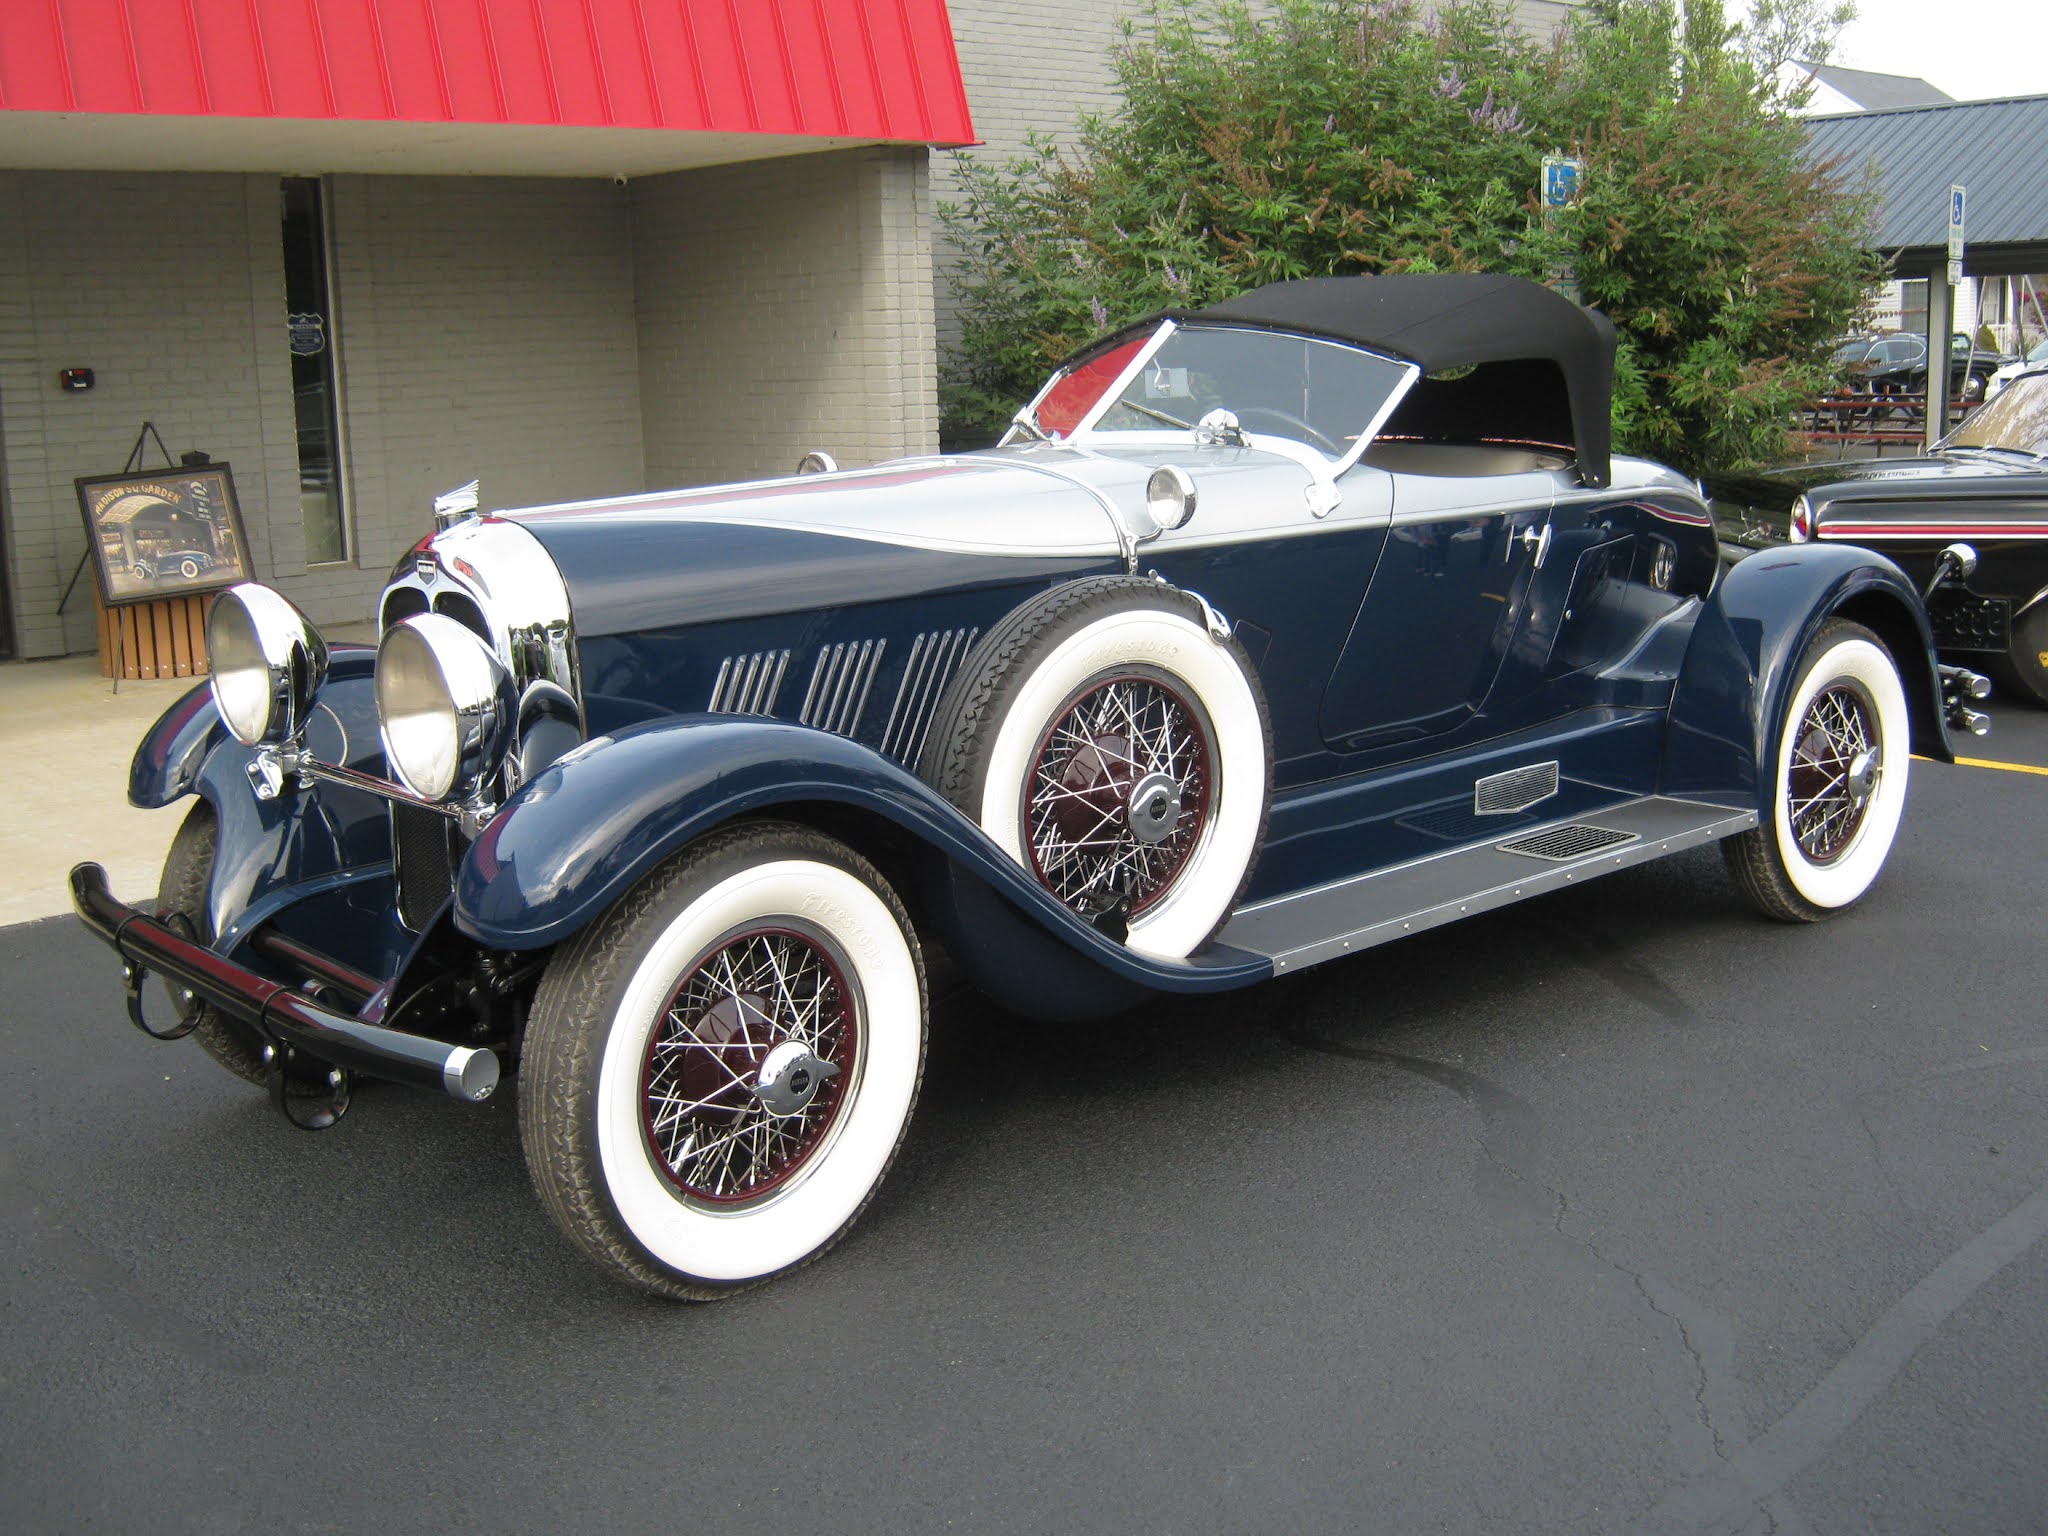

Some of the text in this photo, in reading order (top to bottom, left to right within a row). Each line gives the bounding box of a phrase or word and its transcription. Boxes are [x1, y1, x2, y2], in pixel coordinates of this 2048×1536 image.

[96, 487, 125, 515] MADISON
[142, 484, 181, 505] GARDEN
[800, 891, 887, 969] Firestone
